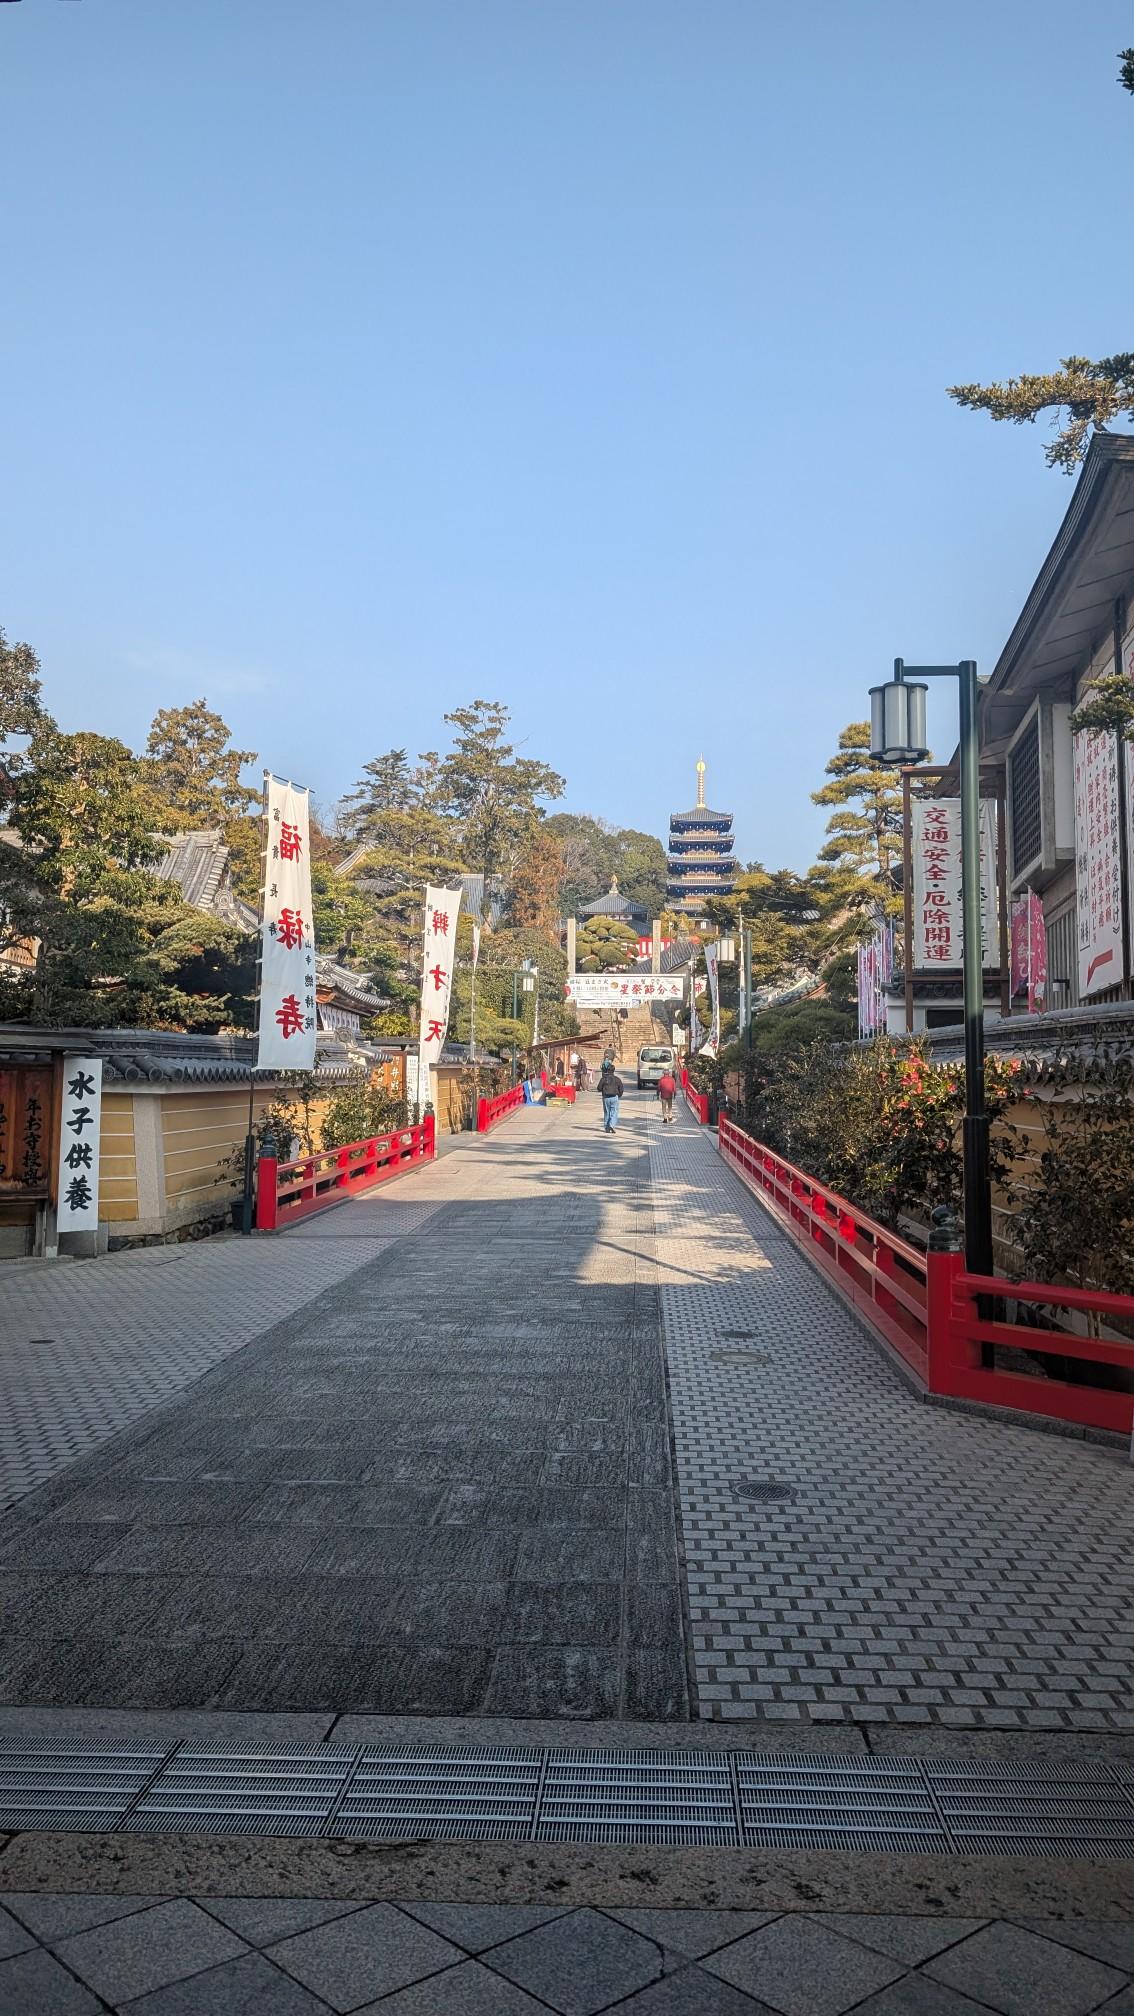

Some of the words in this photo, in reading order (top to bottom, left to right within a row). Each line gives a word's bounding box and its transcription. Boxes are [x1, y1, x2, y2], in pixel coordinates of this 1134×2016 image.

[921, 807, 952, 961] 交通安全・厄除開運
[64, 1071, 96, 1211] 水子供養
